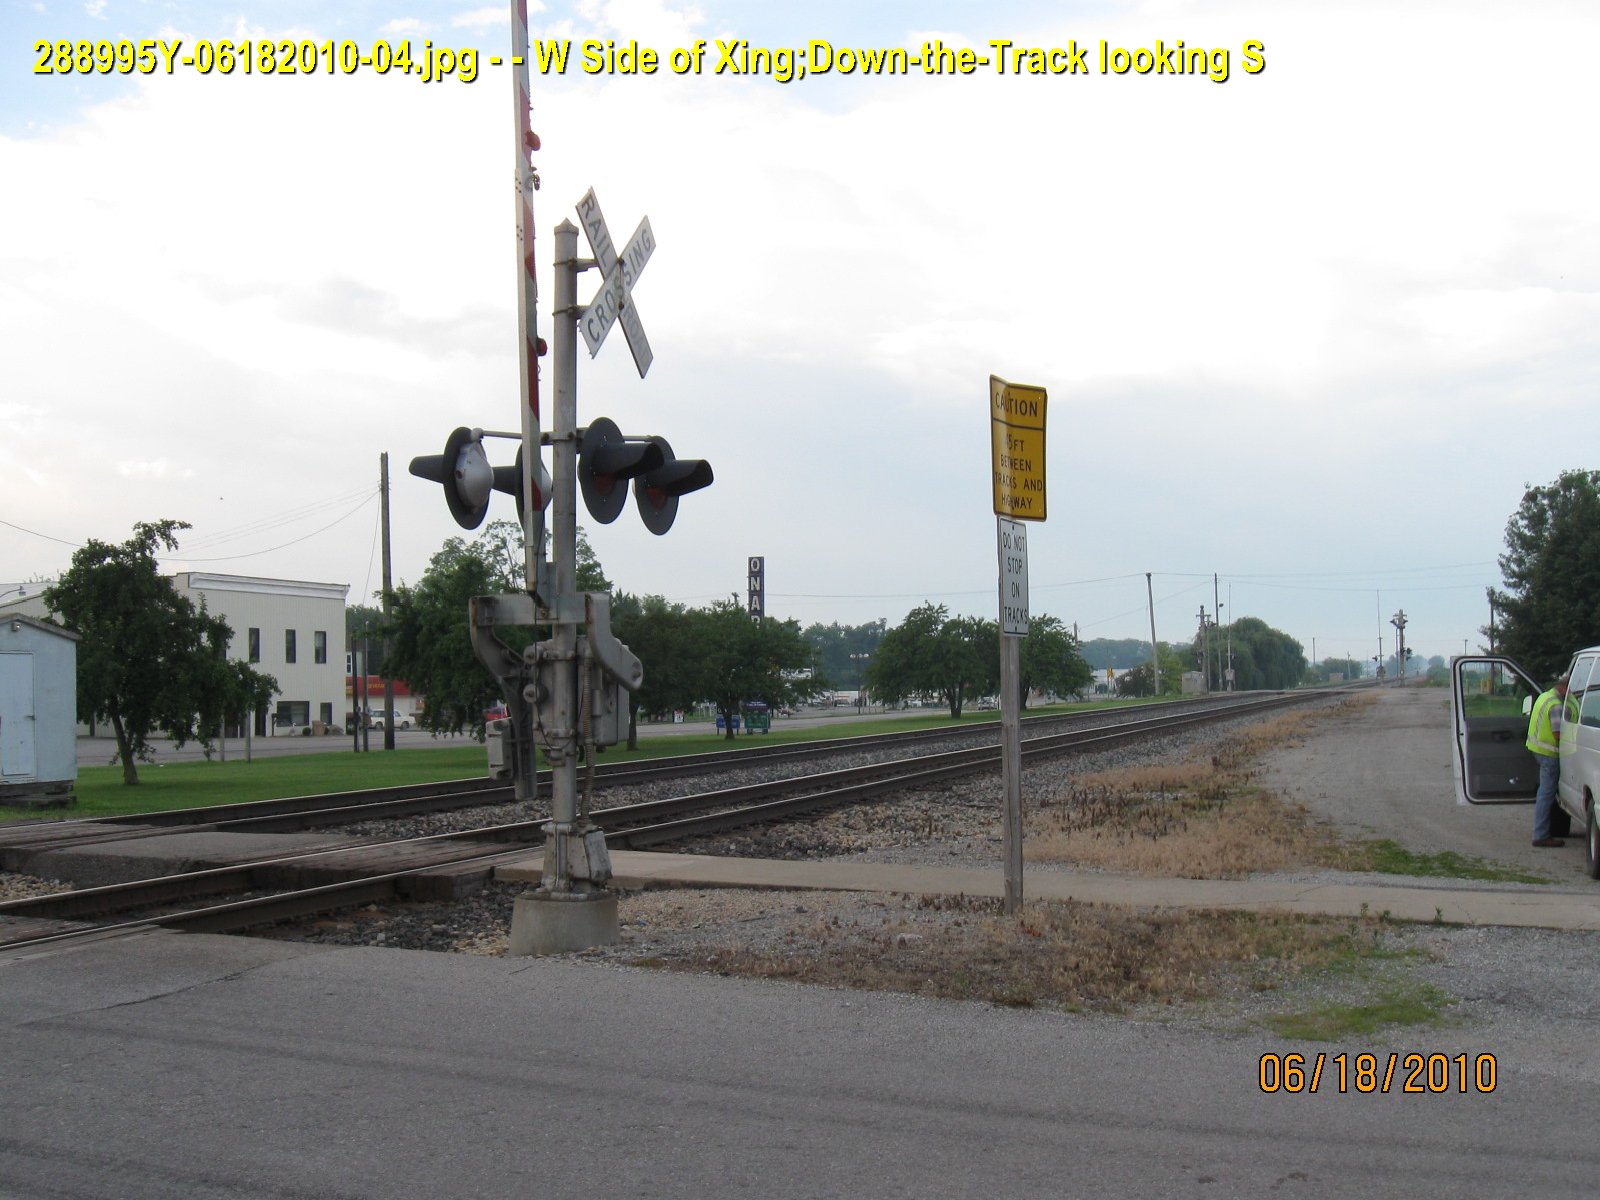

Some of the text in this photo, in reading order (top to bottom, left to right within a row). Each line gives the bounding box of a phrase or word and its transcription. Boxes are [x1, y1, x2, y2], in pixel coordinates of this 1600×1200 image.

[581, 193, 612, 268] RAIL
[587, 228, 651, 343] CROSSING
[1023, 478, 1043, 492] AND
[1003, 532, 1025, 552] DO NOT
[1007, 557, 1023, 575] STOP
[1012, 582, 1020, 598] ON
[1004, 606, 1028, 625] TRACKS
